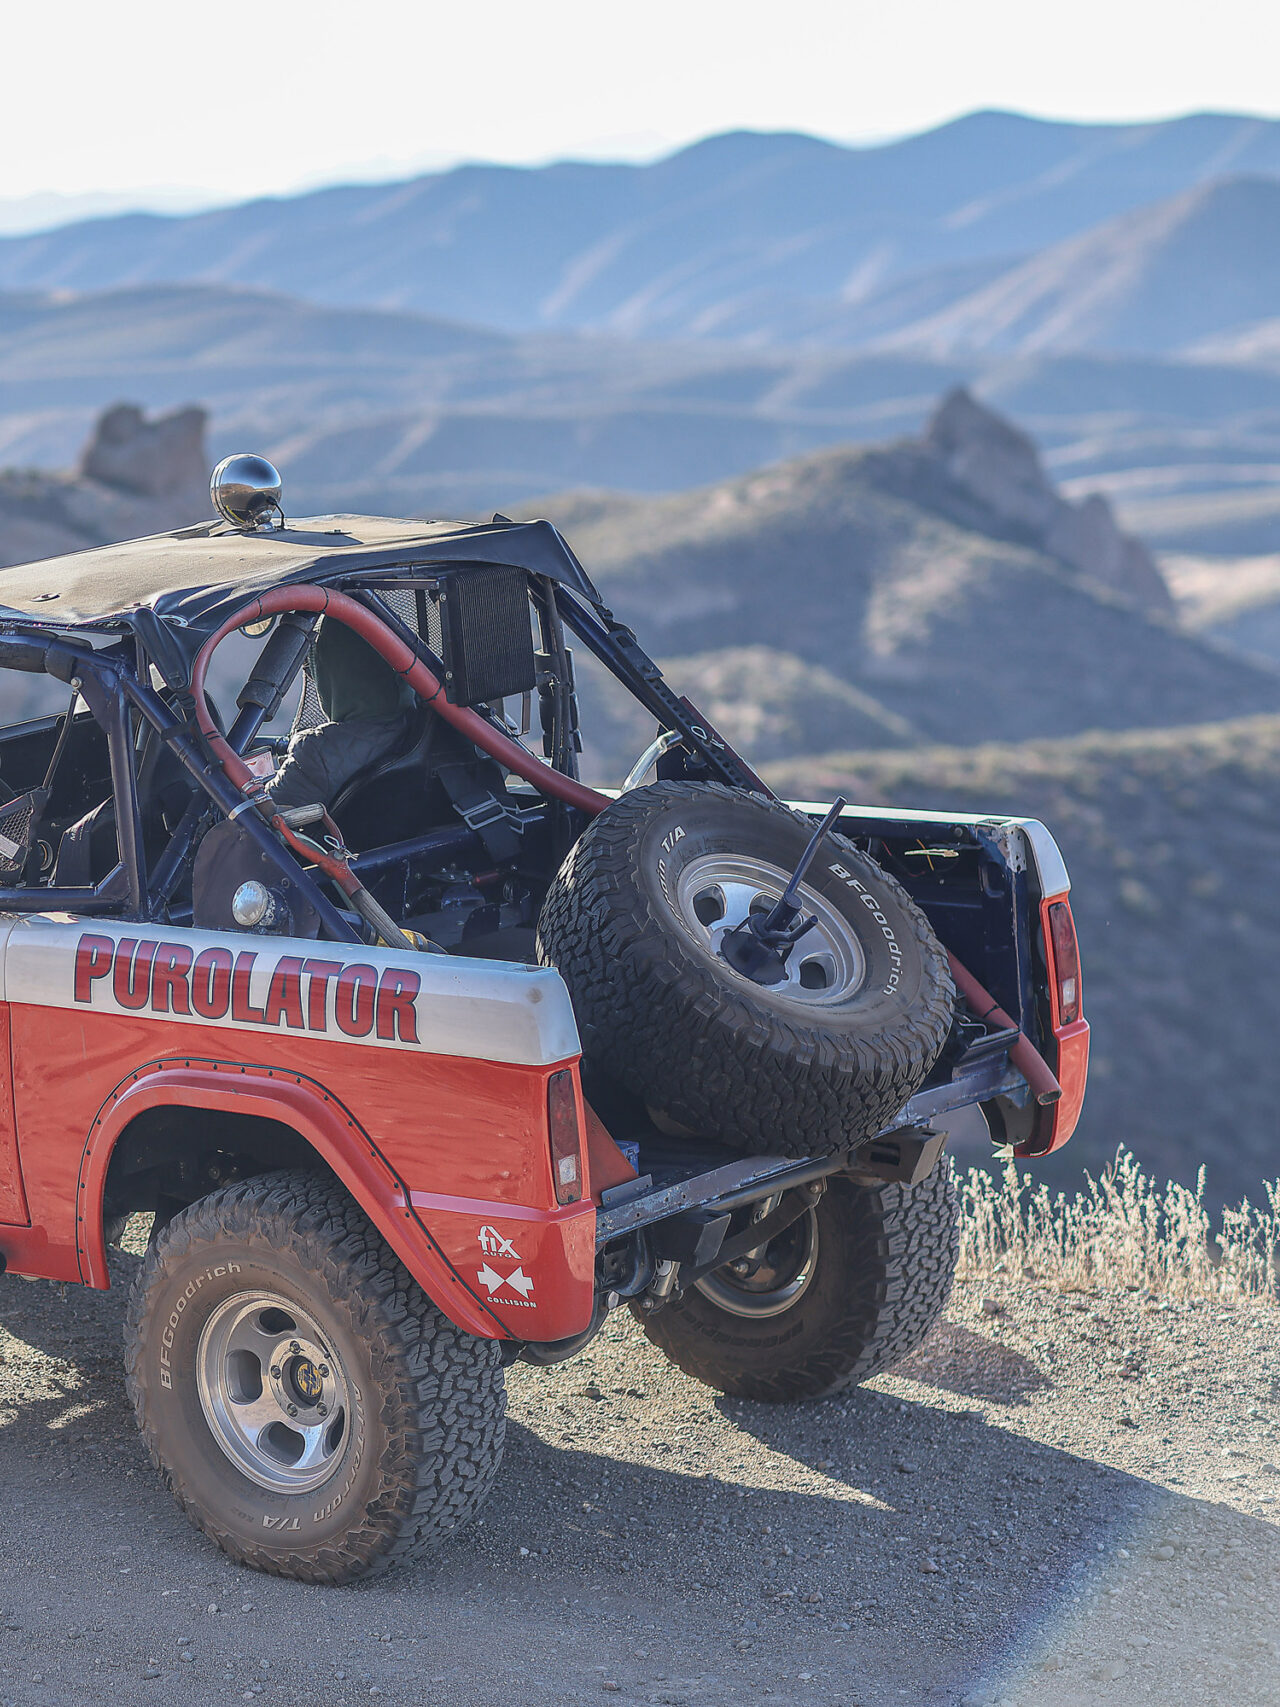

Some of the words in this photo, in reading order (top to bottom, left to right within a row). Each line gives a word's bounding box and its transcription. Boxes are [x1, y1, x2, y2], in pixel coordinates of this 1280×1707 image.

[661, 825, 687, 853] T/A
[827, 863, 904, 996] BFGoodrich
[74, 932, 422, 1045] PUROLATOR
[482, 1250, 513, 1259] AUTO
[160, 1261, 242, 1391] BFGoodrich
[486, 1296, 538, 1309] COLLISION
[312, 1379, 366, 1523] All-Terrain
[262, 1514, 302, 1532] T/A
